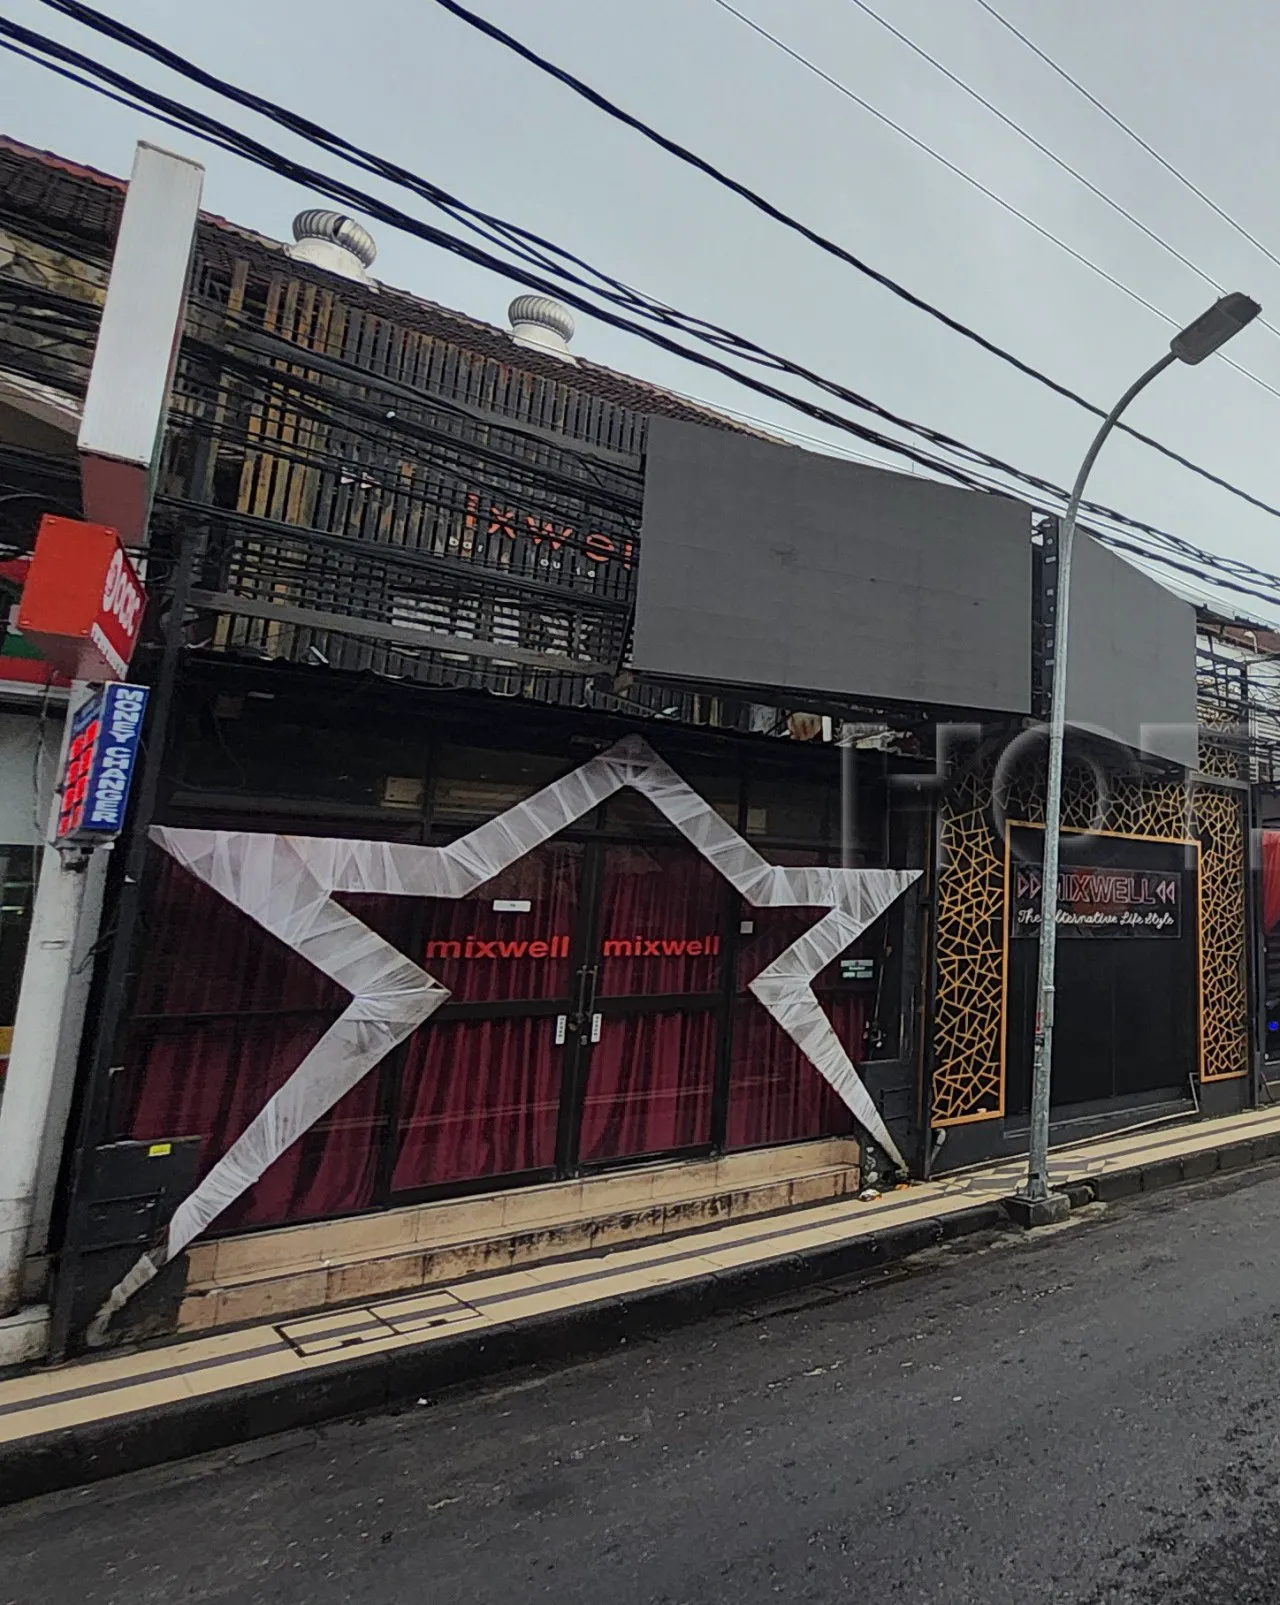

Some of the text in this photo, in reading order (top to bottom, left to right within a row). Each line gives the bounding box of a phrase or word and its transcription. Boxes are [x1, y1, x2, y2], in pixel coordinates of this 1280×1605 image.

[108, 688, 145, 744] MONEY
[90, 746, 132, 824] CHANGER
[1056, 874, 1156, 905] IXWELL
[1018, 908, 1042, 925] The
[1056, 909, 1118, 925] lternative
[426, 935, 570, 959] mixwell
[602, 935, 721, 958] mixwell
